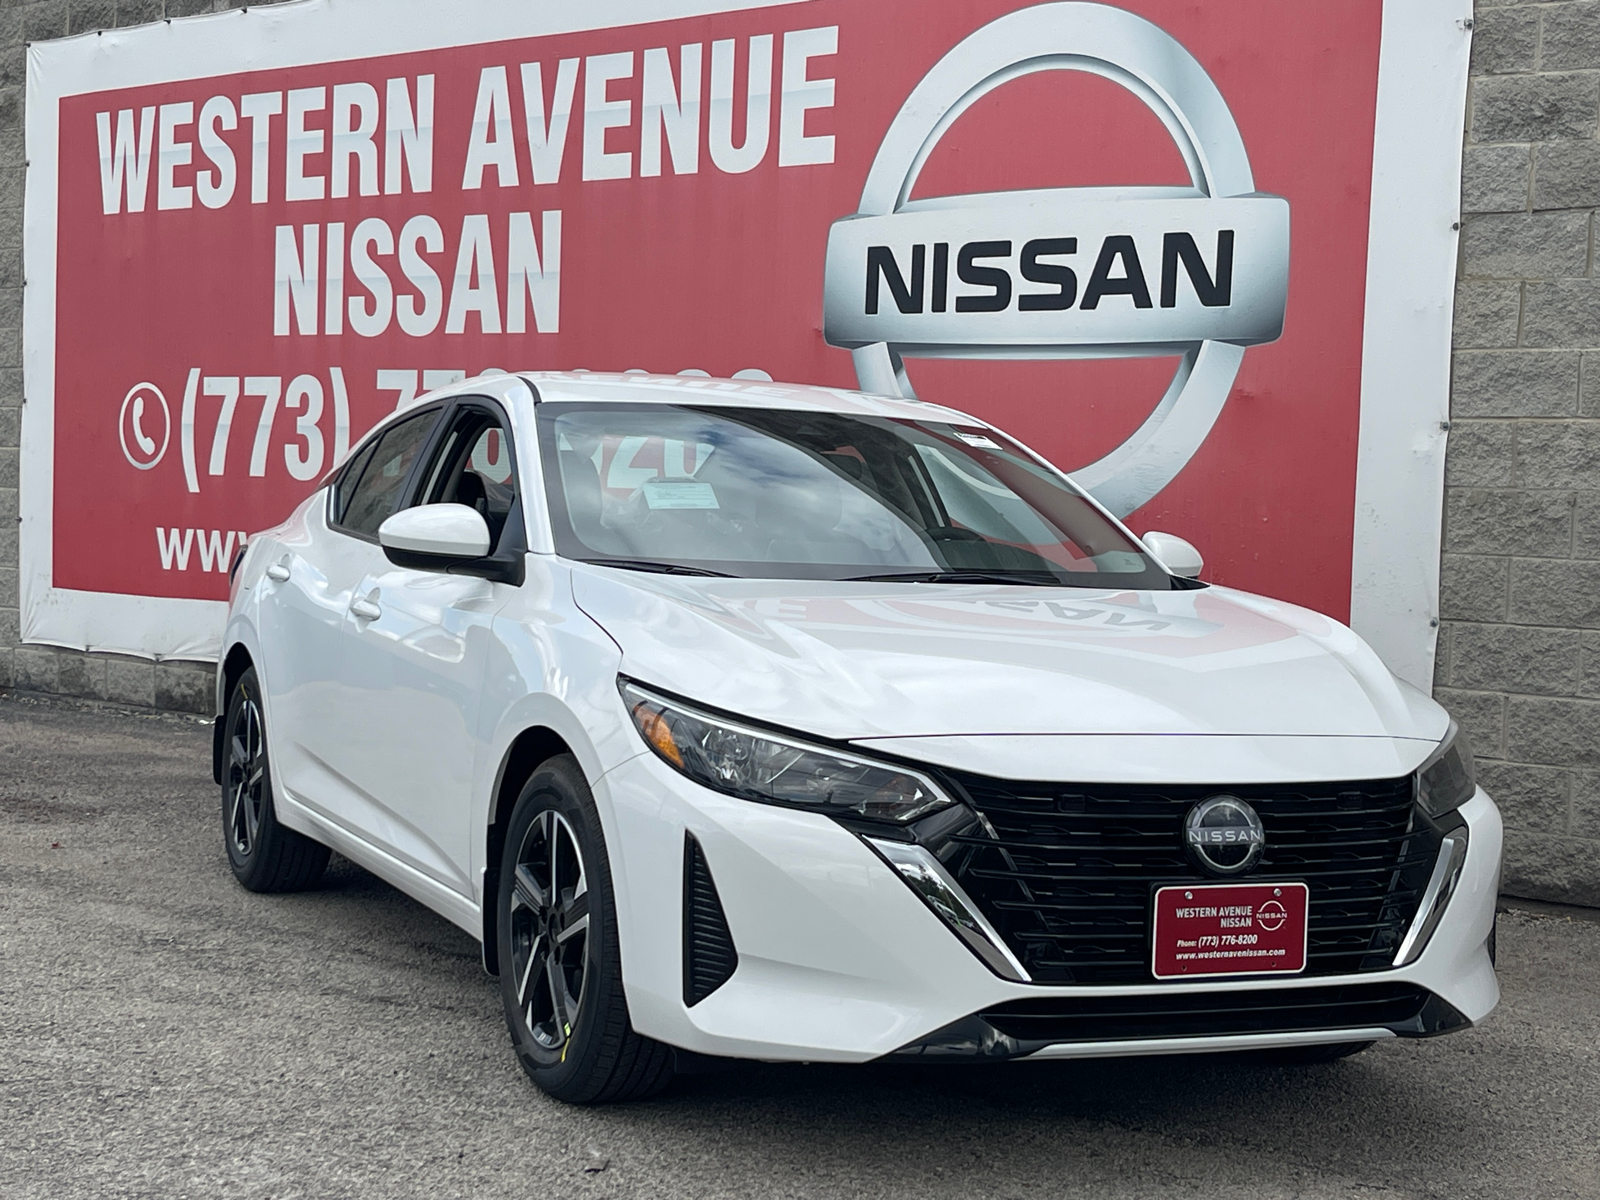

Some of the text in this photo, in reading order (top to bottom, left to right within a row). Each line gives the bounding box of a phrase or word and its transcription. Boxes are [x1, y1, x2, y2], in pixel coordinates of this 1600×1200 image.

[96, 25, 840, 215] WESTERN AVENUE
[273, 209, 563, 338] NISSAN
[865, 229, 1235, 315] NISSAN
[181, 367, 350, 493] (773)
[1188, 828, 1261, 842] NISSAN
[1175, 905, 1253, 919] WESTERN AVENUE
[1220, 917, 1252, 928] NISSAN
[1176, 934, 1258, 949] Phone: (773) 776-8200
[1175, 948, 1286, 960] www.westernavenissan.com
